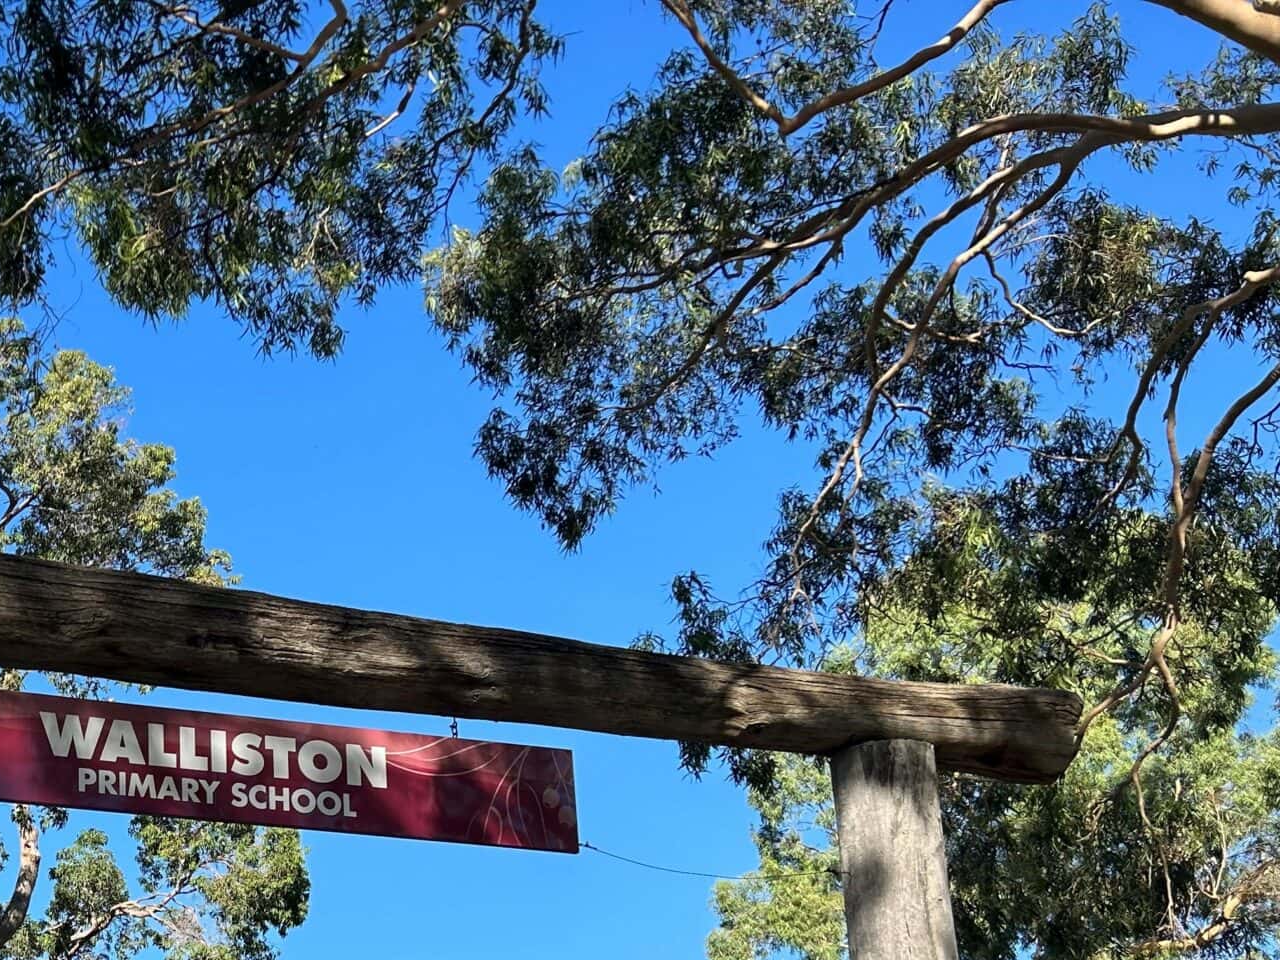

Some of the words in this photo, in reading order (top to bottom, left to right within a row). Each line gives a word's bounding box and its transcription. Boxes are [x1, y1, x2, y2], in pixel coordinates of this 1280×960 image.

[39, 711, 388, 789] WALLISTON
[78, 767, 220, 805] PRIMARY
[231, 781, 357, 818] SCHOOL
